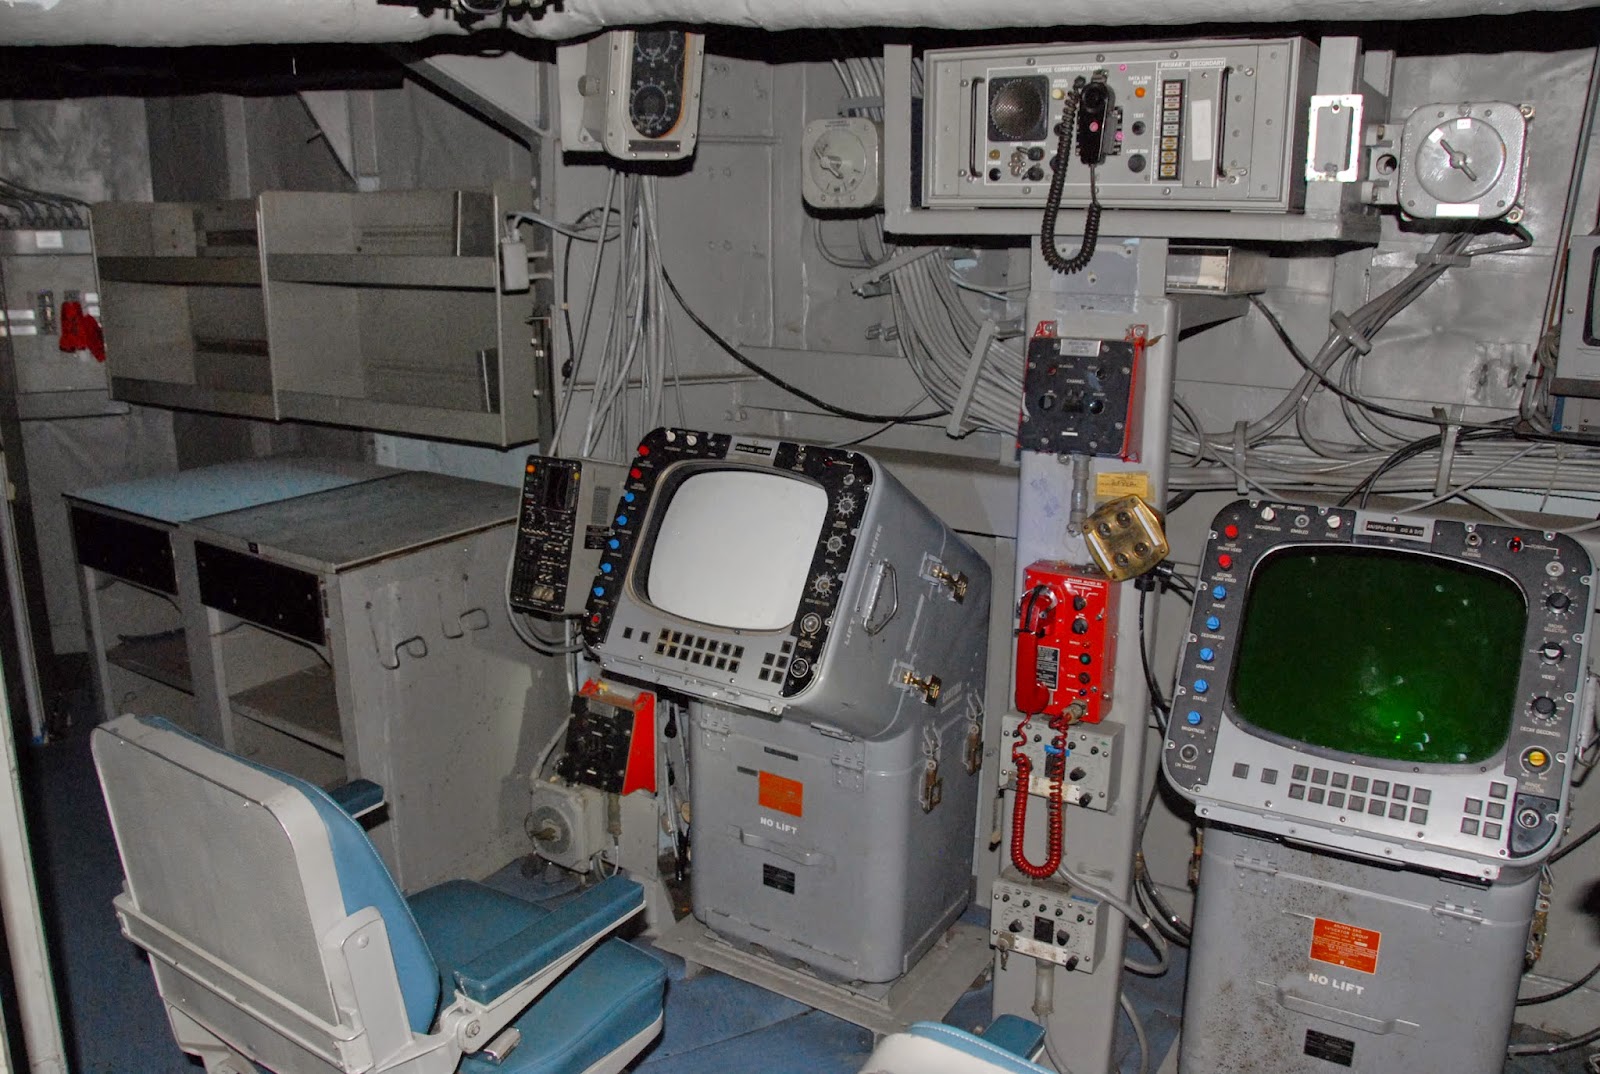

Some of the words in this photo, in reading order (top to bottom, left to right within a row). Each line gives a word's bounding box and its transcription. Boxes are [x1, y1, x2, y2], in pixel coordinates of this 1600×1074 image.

[1181, 726, 1205, 734] BRIGHTNESS
[760, 817, 773, 827] NO
[776, 822, 798, 834] LIFT
[1308, 973, 1328, 985] NO
[1332, 979, 1365, 995] LIFT
